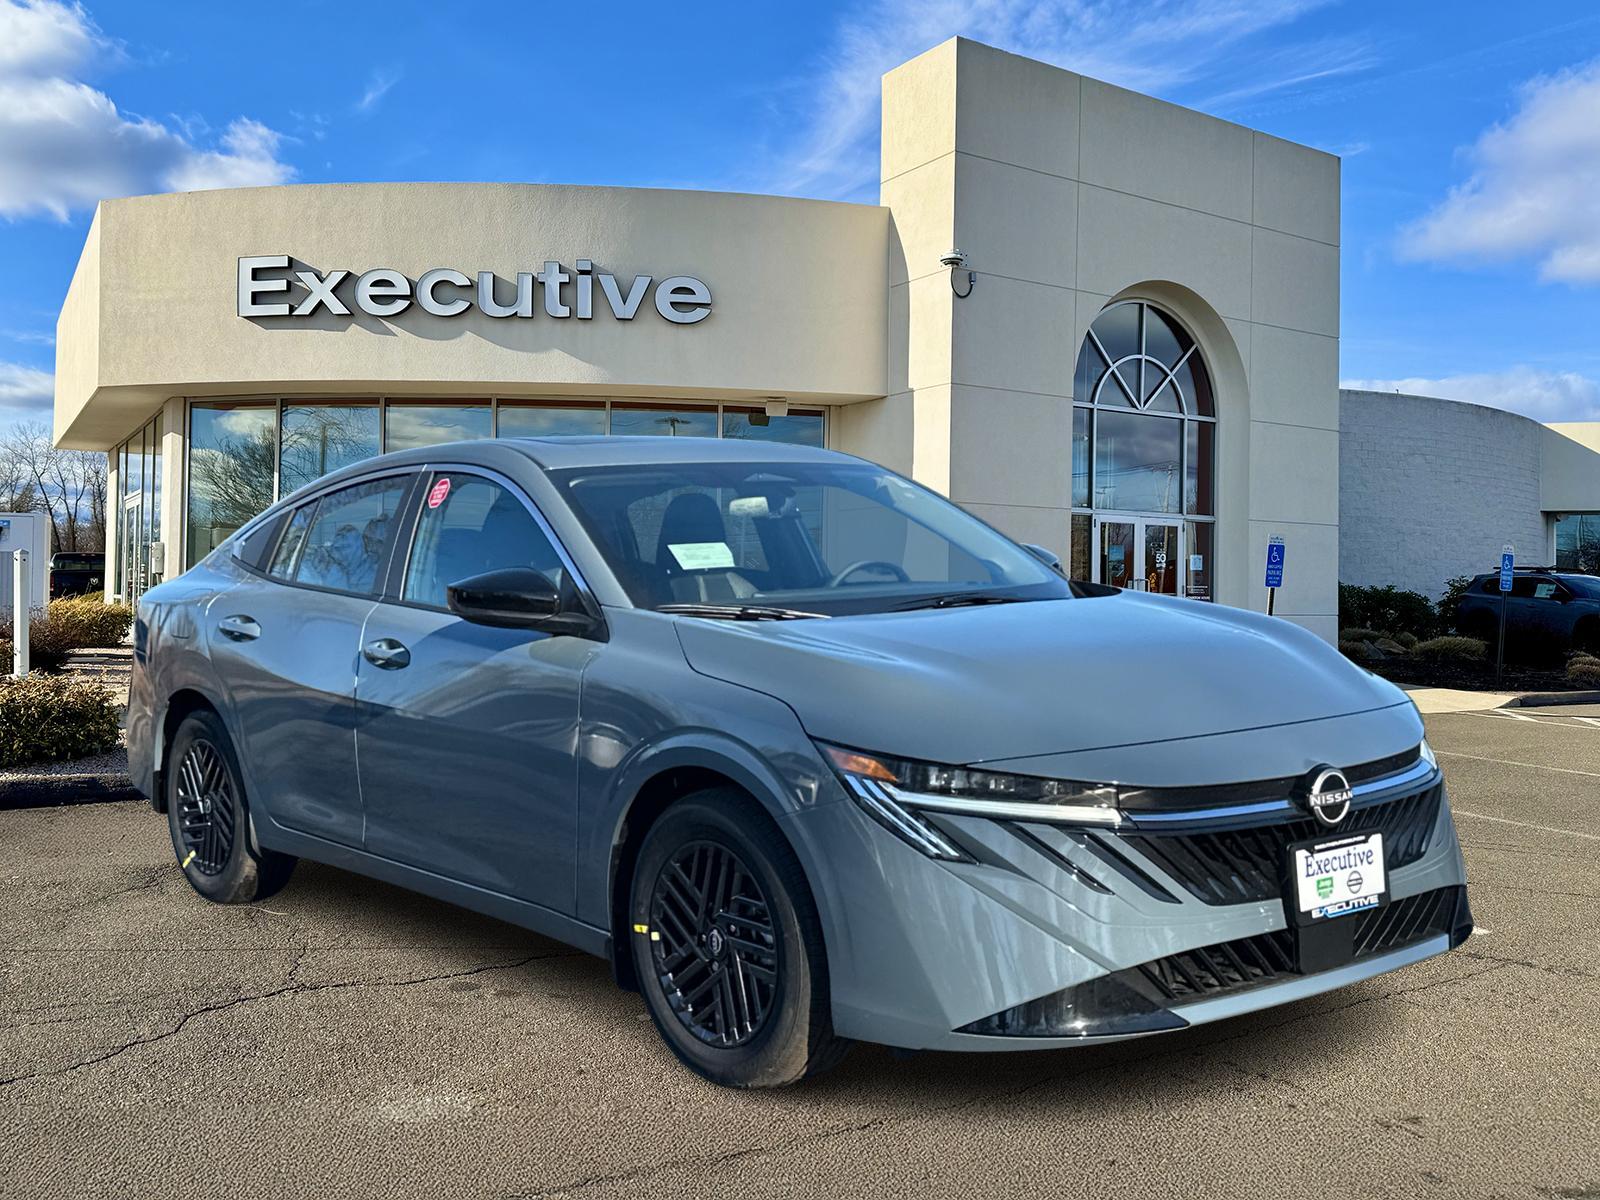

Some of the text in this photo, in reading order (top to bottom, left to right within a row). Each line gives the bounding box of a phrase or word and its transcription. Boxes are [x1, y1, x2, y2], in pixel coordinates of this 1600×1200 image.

[237, 255, 713, 325] Executive
[1155, 553, 1167, 563] 50
[1309, 790, 1353, 807] NISSAN
[1304, 846, 1374, 878] Executive
